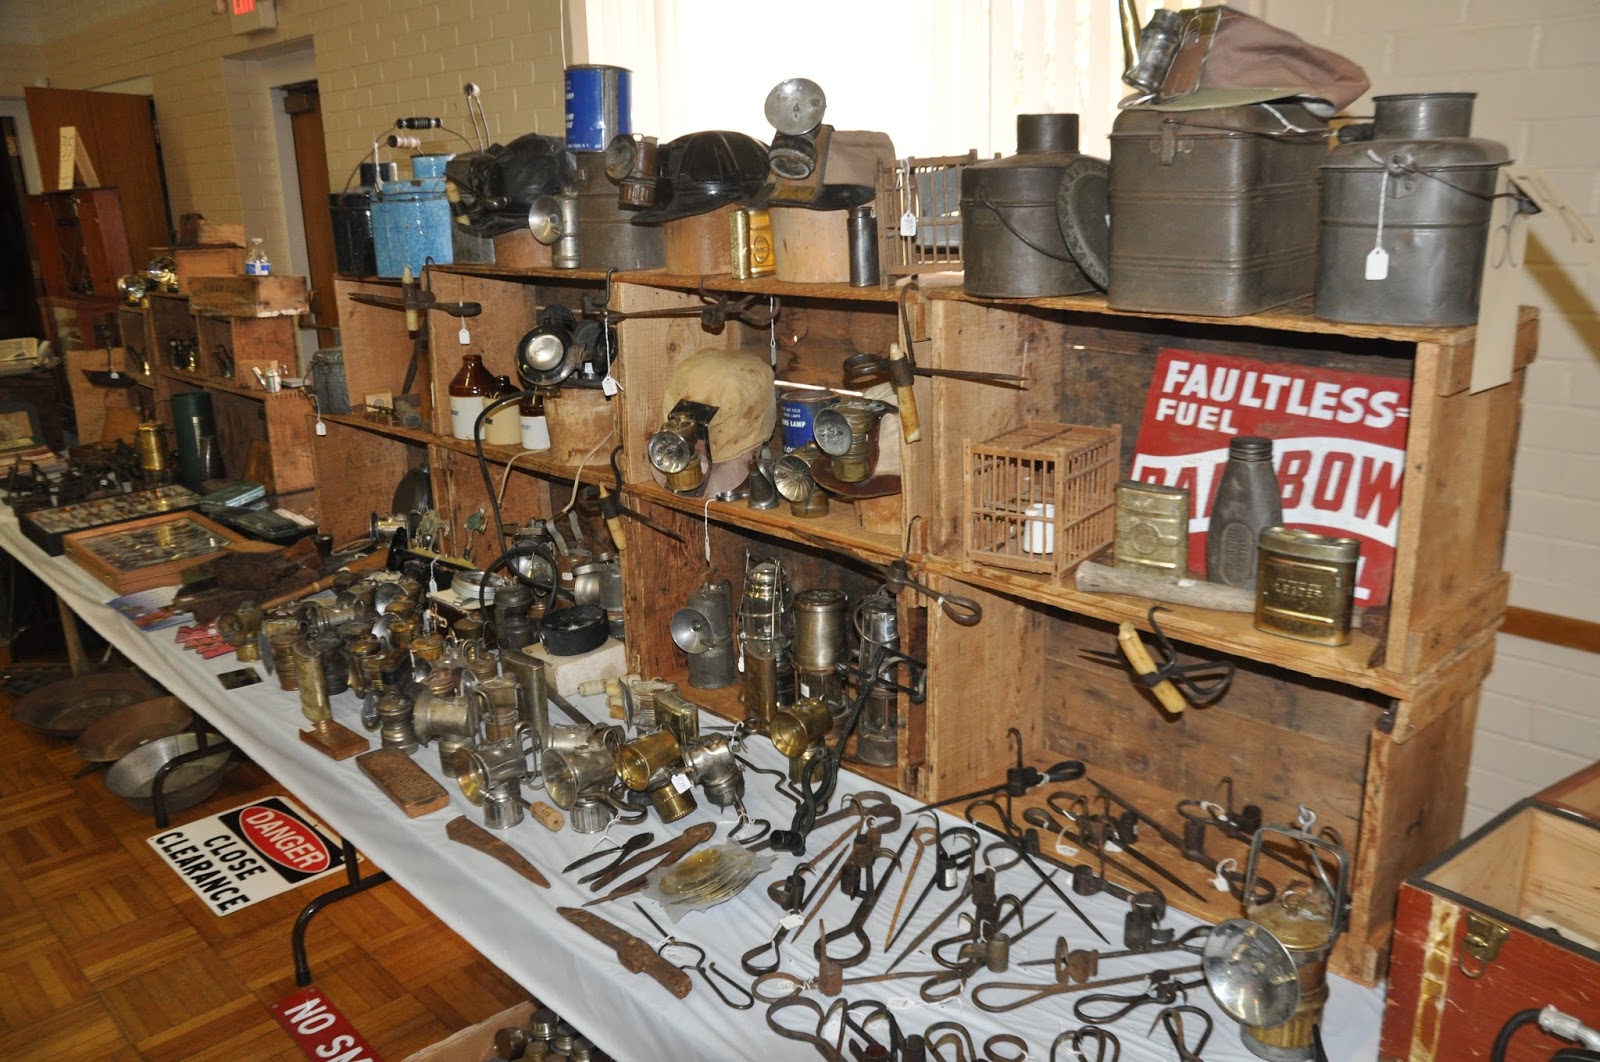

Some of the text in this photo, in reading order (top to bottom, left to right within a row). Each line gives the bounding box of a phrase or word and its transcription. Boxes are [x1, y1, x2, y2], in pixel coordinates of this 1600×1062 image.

[790, 420, 806, 428] LAMP
[1155, 398, 1239, 435] FUEL
[203, 834, 267, 881] CLOSE
[245, 810, 327, 869] DANGER
[155, 831, 251, 912] CLEARANCE
[283, 997, 336, 1035] NO
